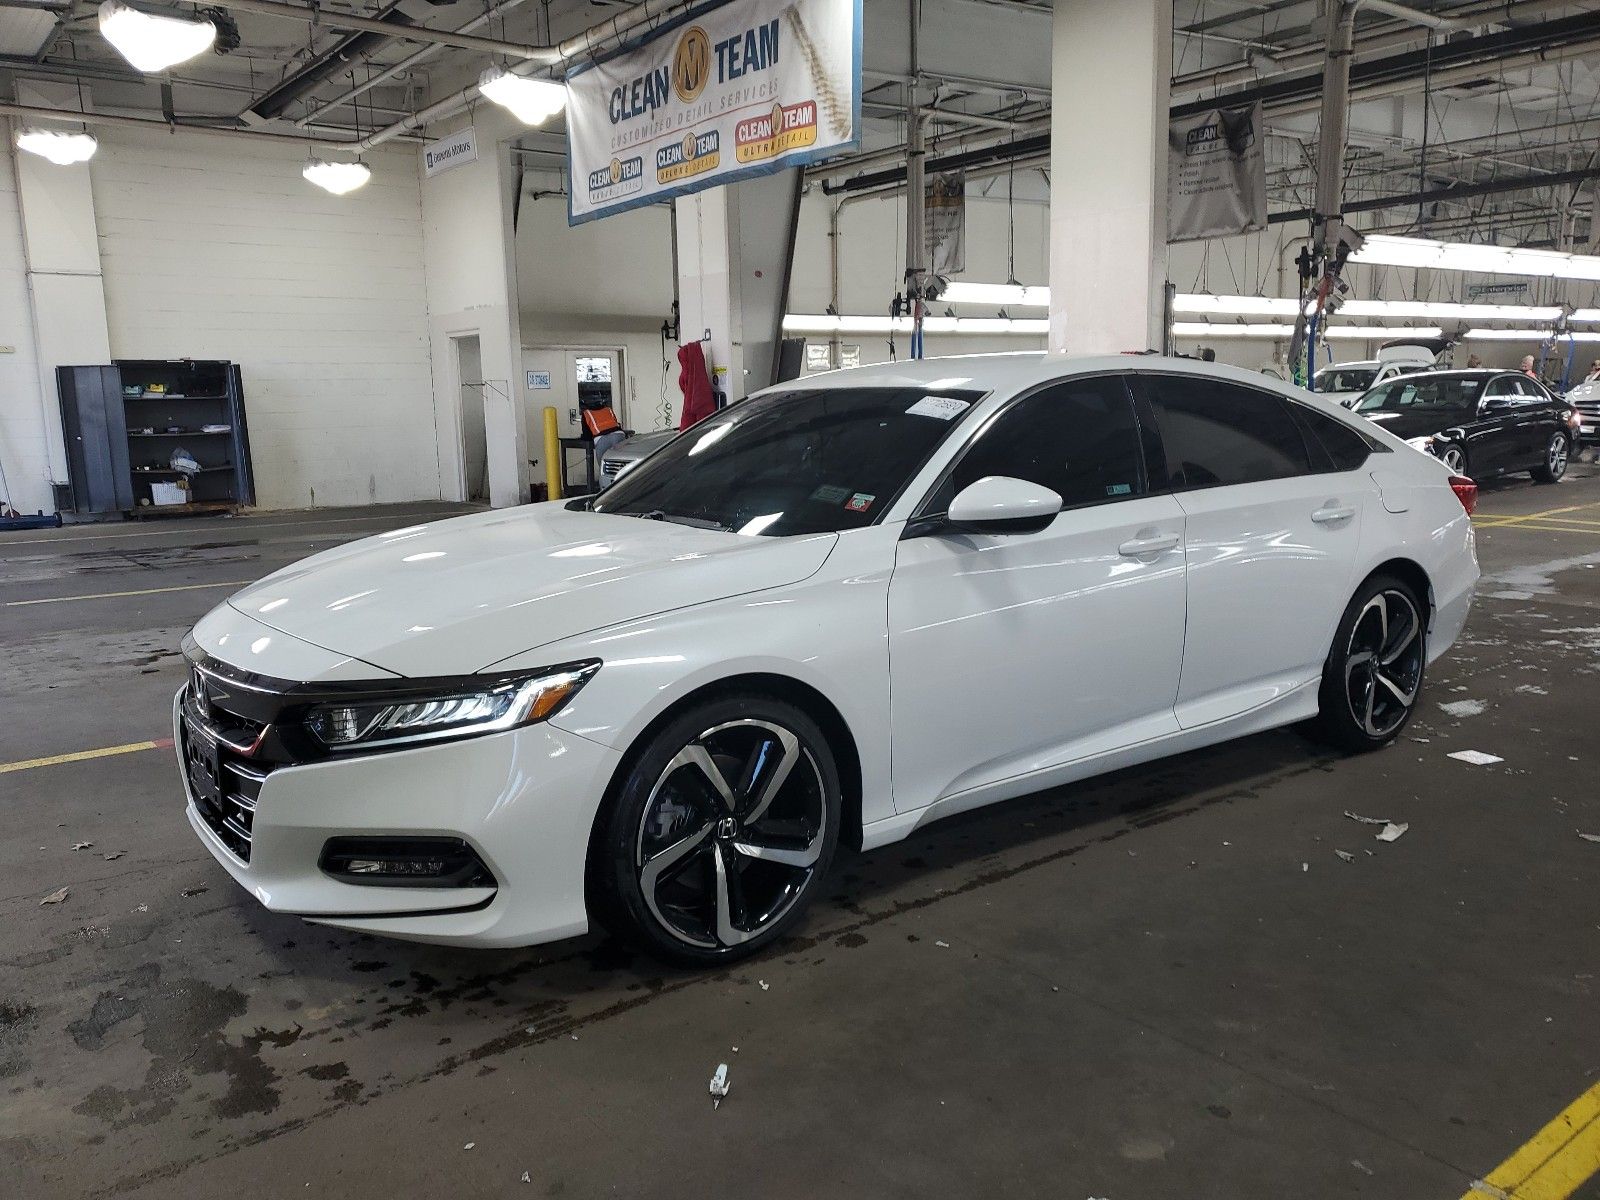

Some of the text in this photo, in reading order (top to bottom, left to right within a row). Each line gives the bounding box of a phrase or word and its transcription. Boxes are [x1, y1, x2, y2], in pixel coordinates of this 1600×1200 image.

[609, 65, 669, 125] CLEAN
[715, 18, 780, 84] TEAM
[611, 78, 779, 148] CUSTOMIZED DETAIL SERVICES
[738, 105, 813, 142] CLEAN TEAM
[658, 133, 718, 167] CLEAN TEAM
[743, 140, 775, 157] ULTRA
[1188, 127, 1217, 142] CLEAN
[589, 159, 641, 189] CLEAN TEAM
[1482, 285, 1528, 293] Enterprise
